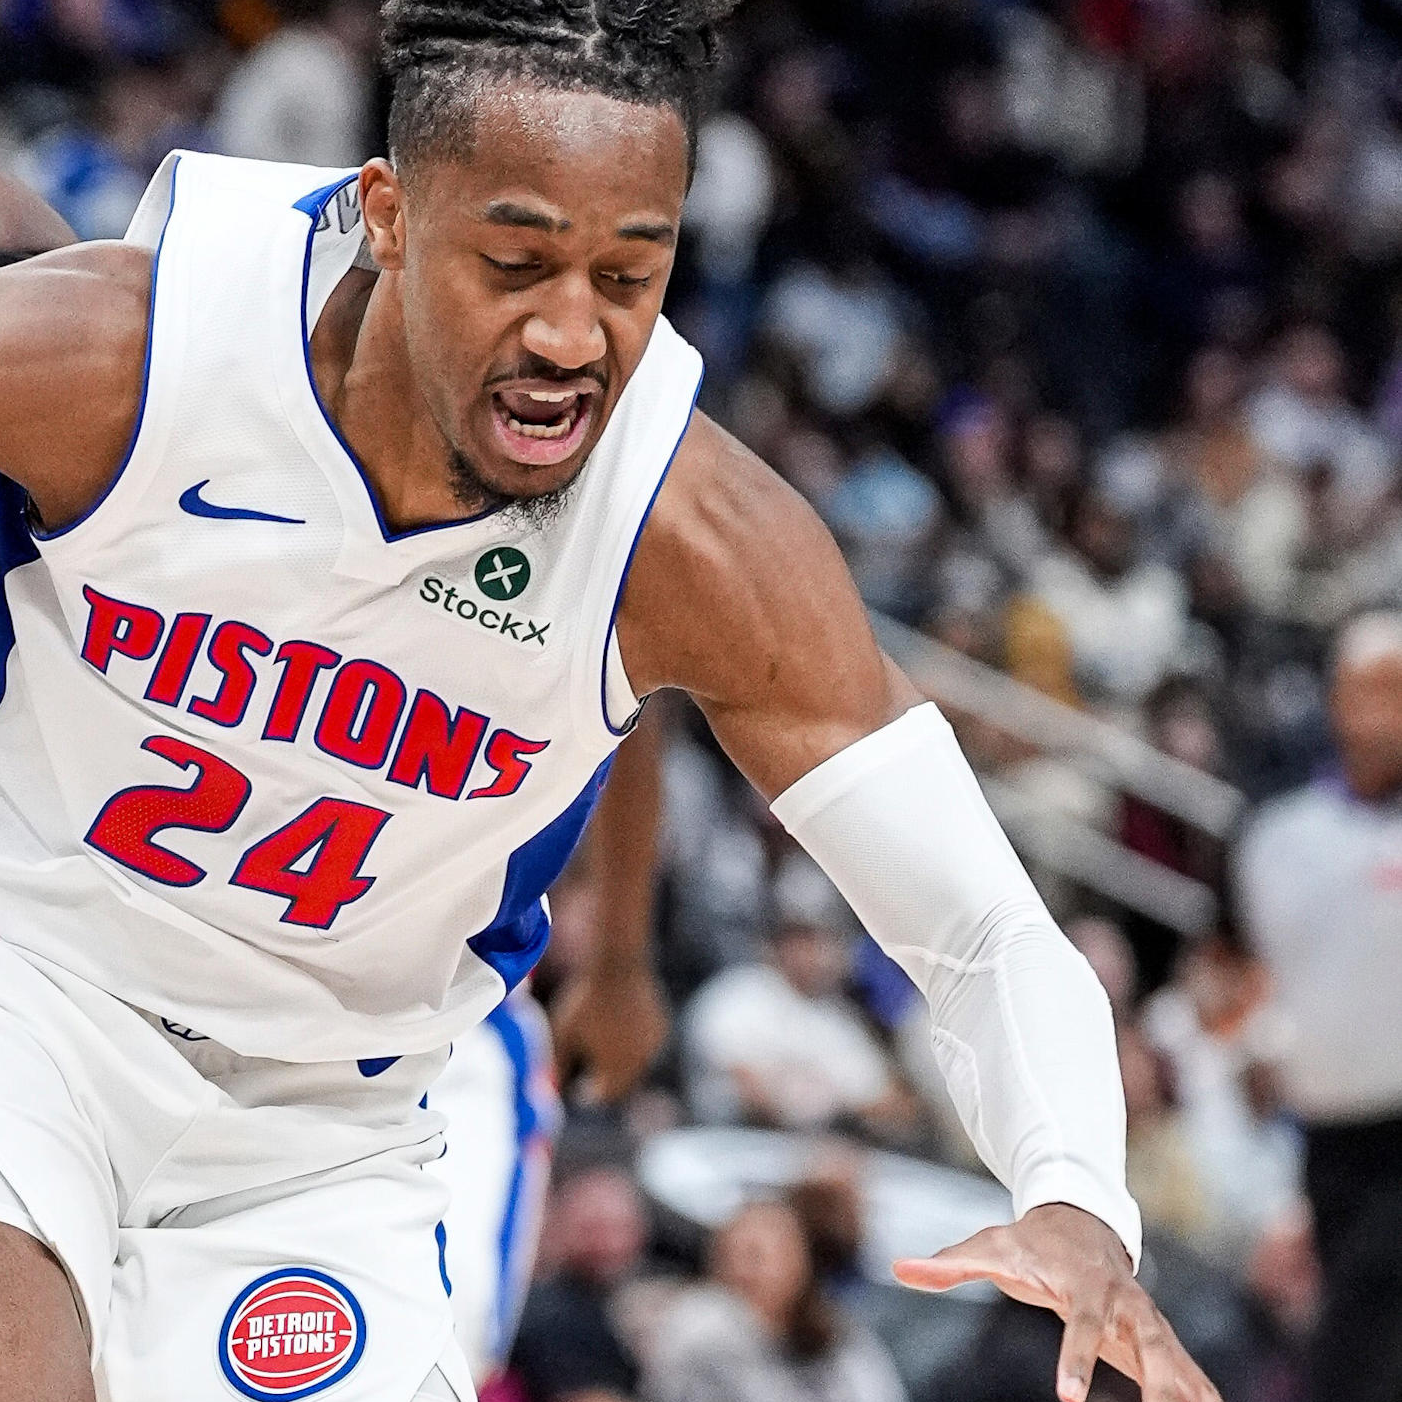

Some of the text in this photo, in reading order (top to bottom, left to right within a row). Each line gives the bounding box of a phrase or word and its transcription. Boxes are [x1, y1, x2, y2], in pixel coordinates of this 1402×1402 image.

[419, 577, 551, 647] StockX
[81, 584, 552, 801] PISTONS
[83, 735, 395, 930] 24
[245, 1332, 337, 1361] PISTONS
[247, 1311, 337, 1338] DETROIT
